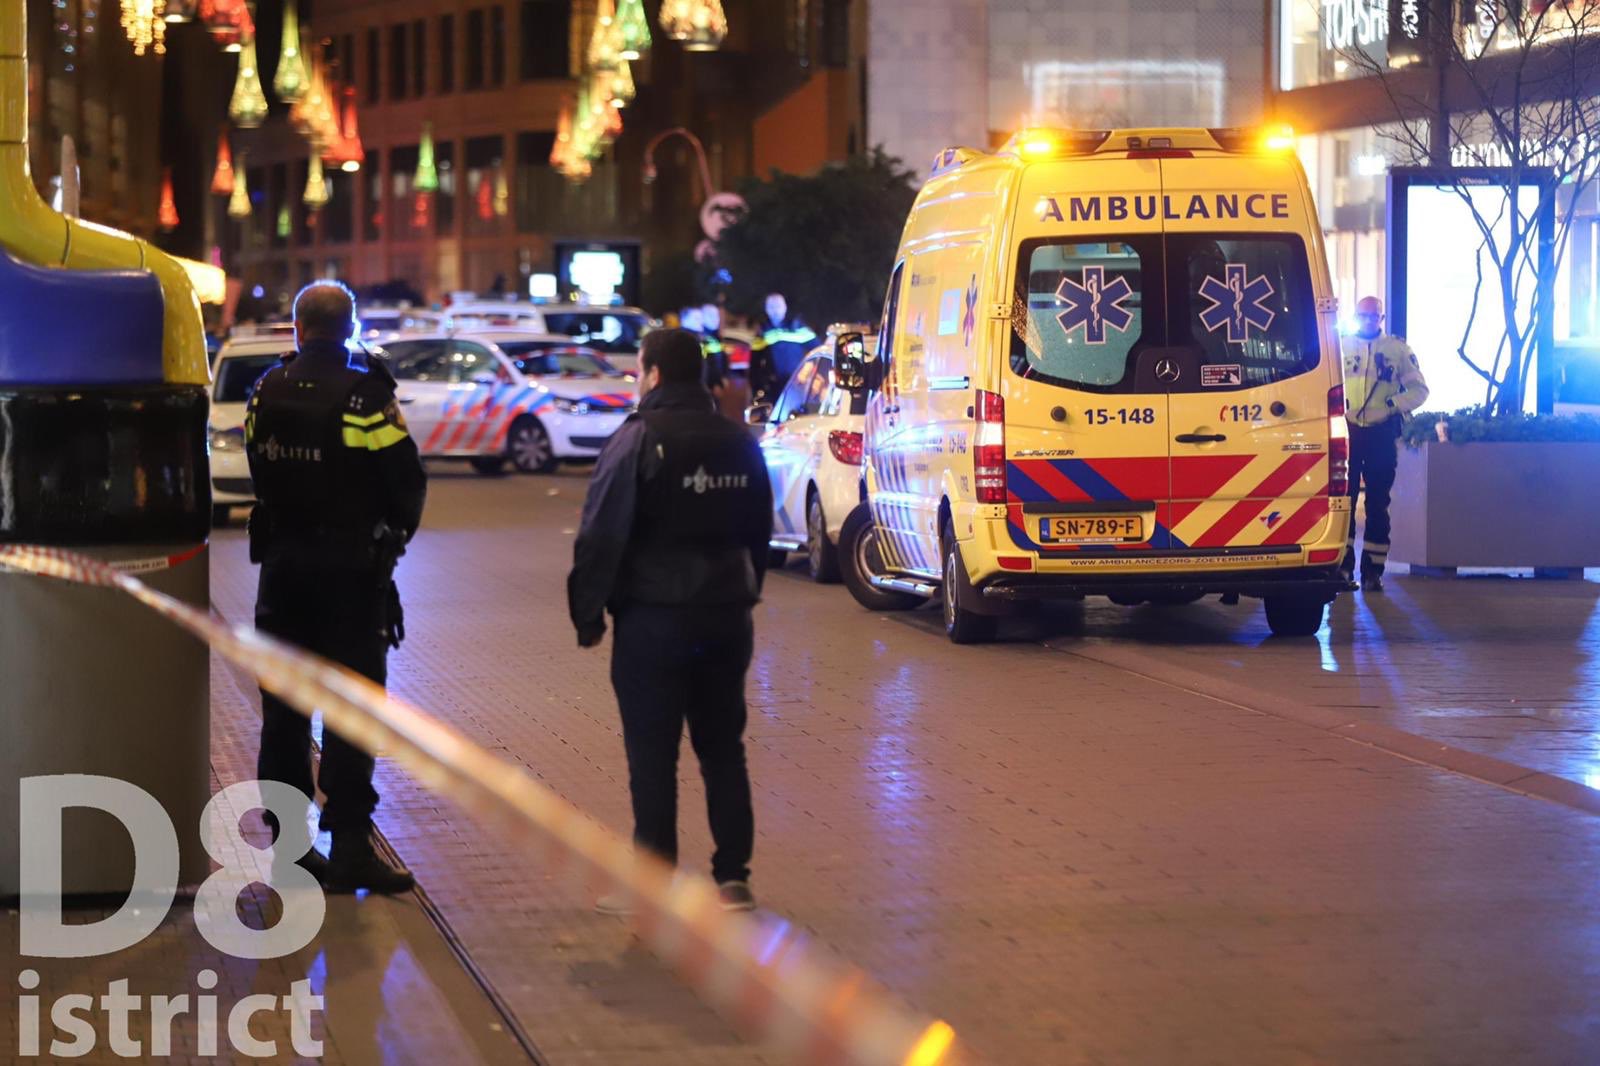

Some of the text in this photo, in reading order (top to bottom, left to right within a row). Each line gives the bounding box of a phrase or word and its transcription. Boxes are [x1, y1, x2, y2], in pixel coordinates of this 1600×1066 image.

[1039, 194, 1289, 222] AMBULANCE
[1084, 408, 1155, 425] 15-148
[258, 437, 322, 461] POLITIE
[683, 468, 748, 493] POLITIE
[1056, 520, 1134, 535] SN-789-F
